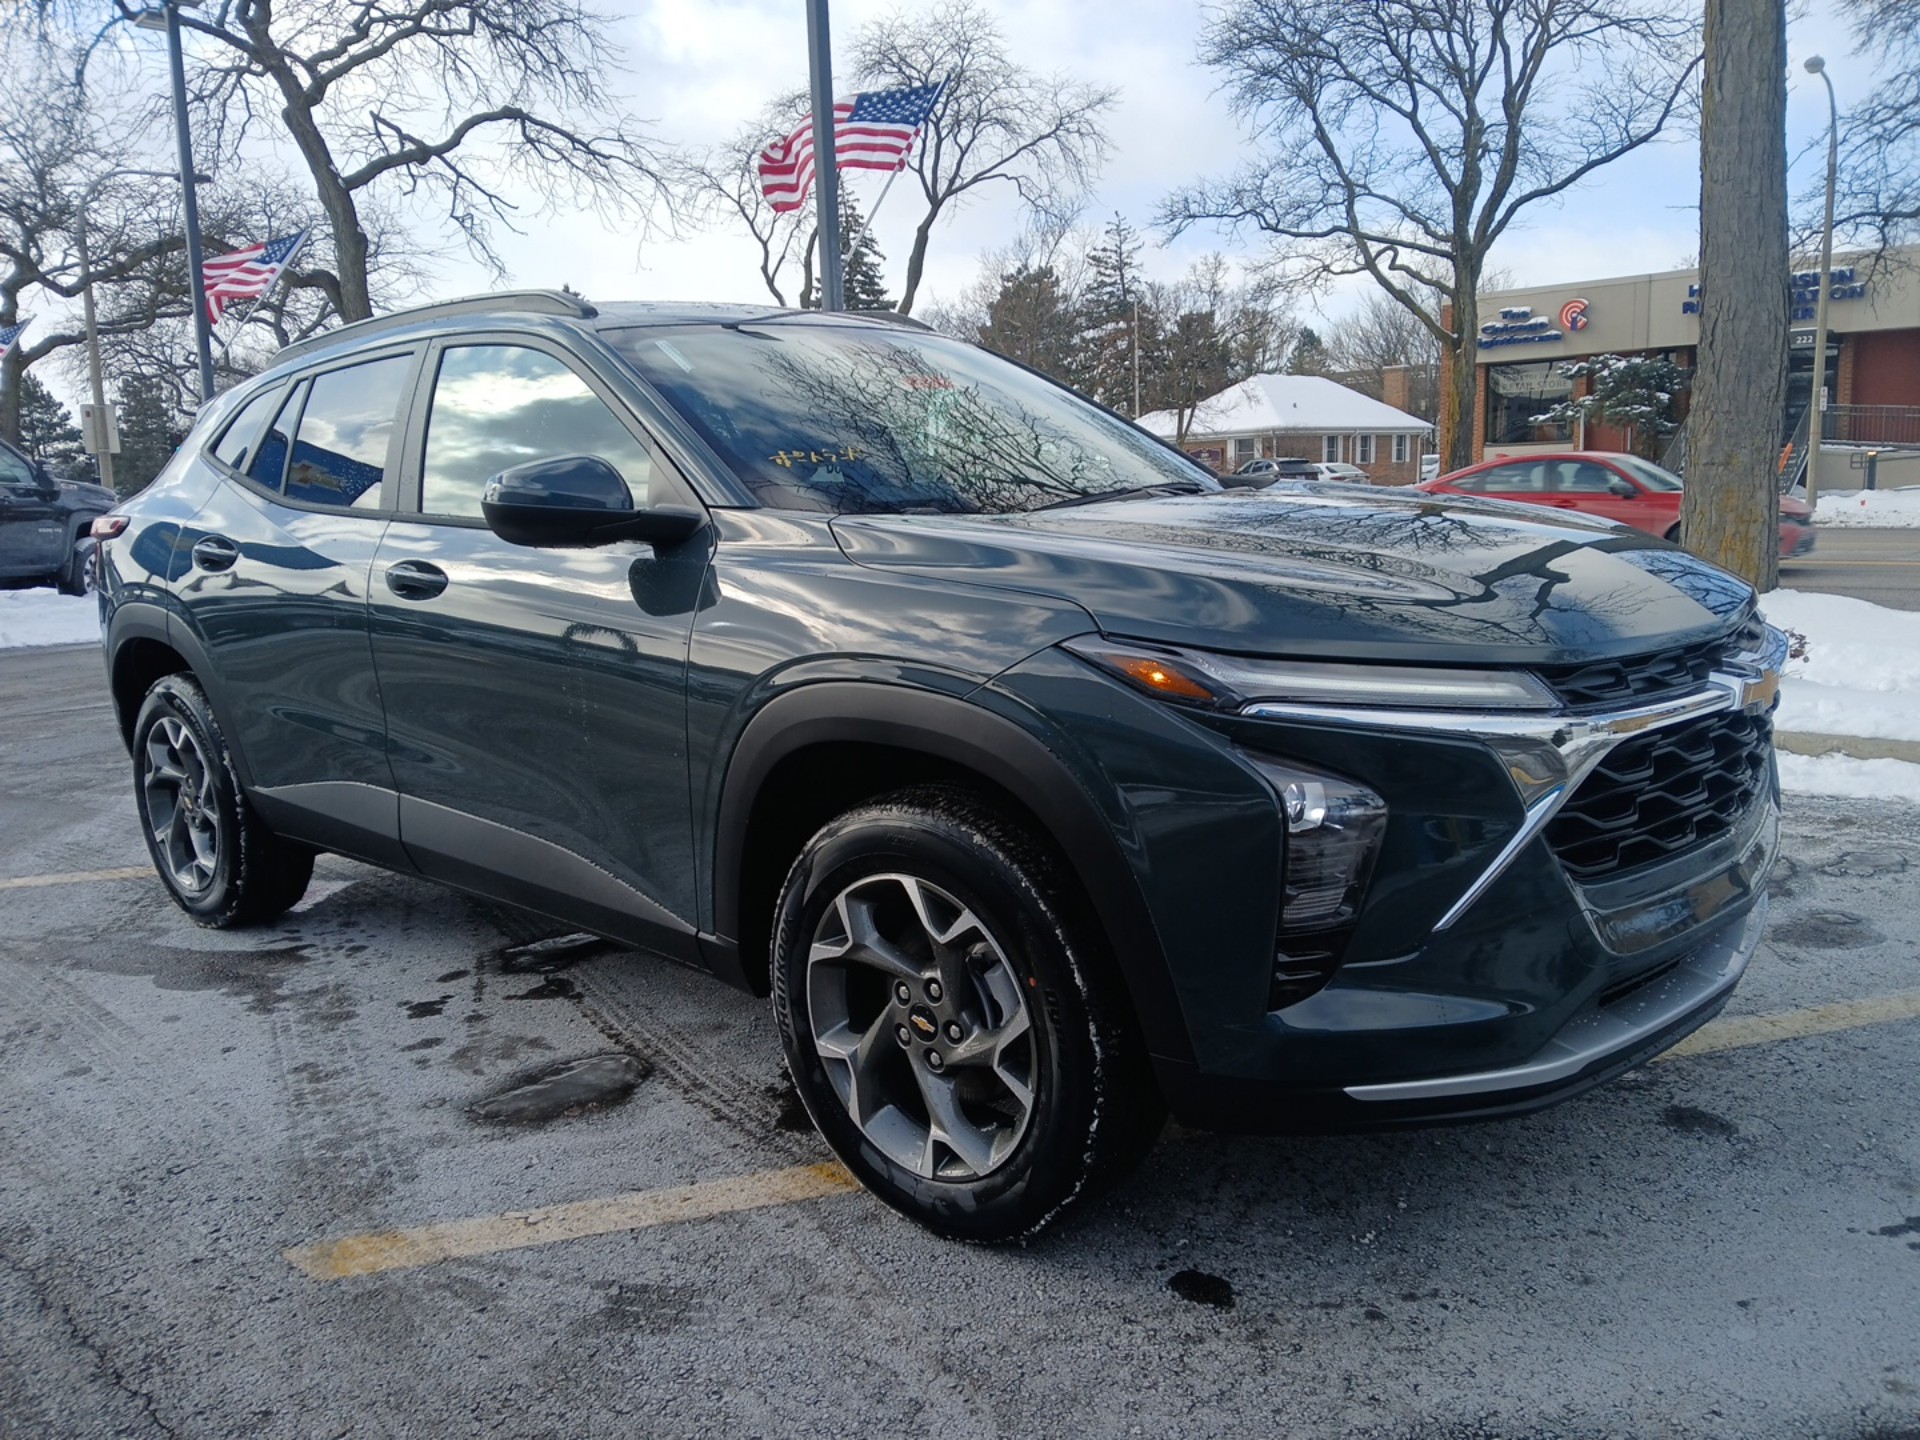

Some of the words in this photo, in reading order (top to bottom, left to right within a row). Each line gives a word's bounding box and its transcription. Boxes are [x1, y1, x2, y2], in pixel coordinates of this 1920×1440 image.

[1477, 332, 1562, 349] ighthouse
[1796, 335, 1813, 344] 222
[1537, 379, 1568, 388] STORE
